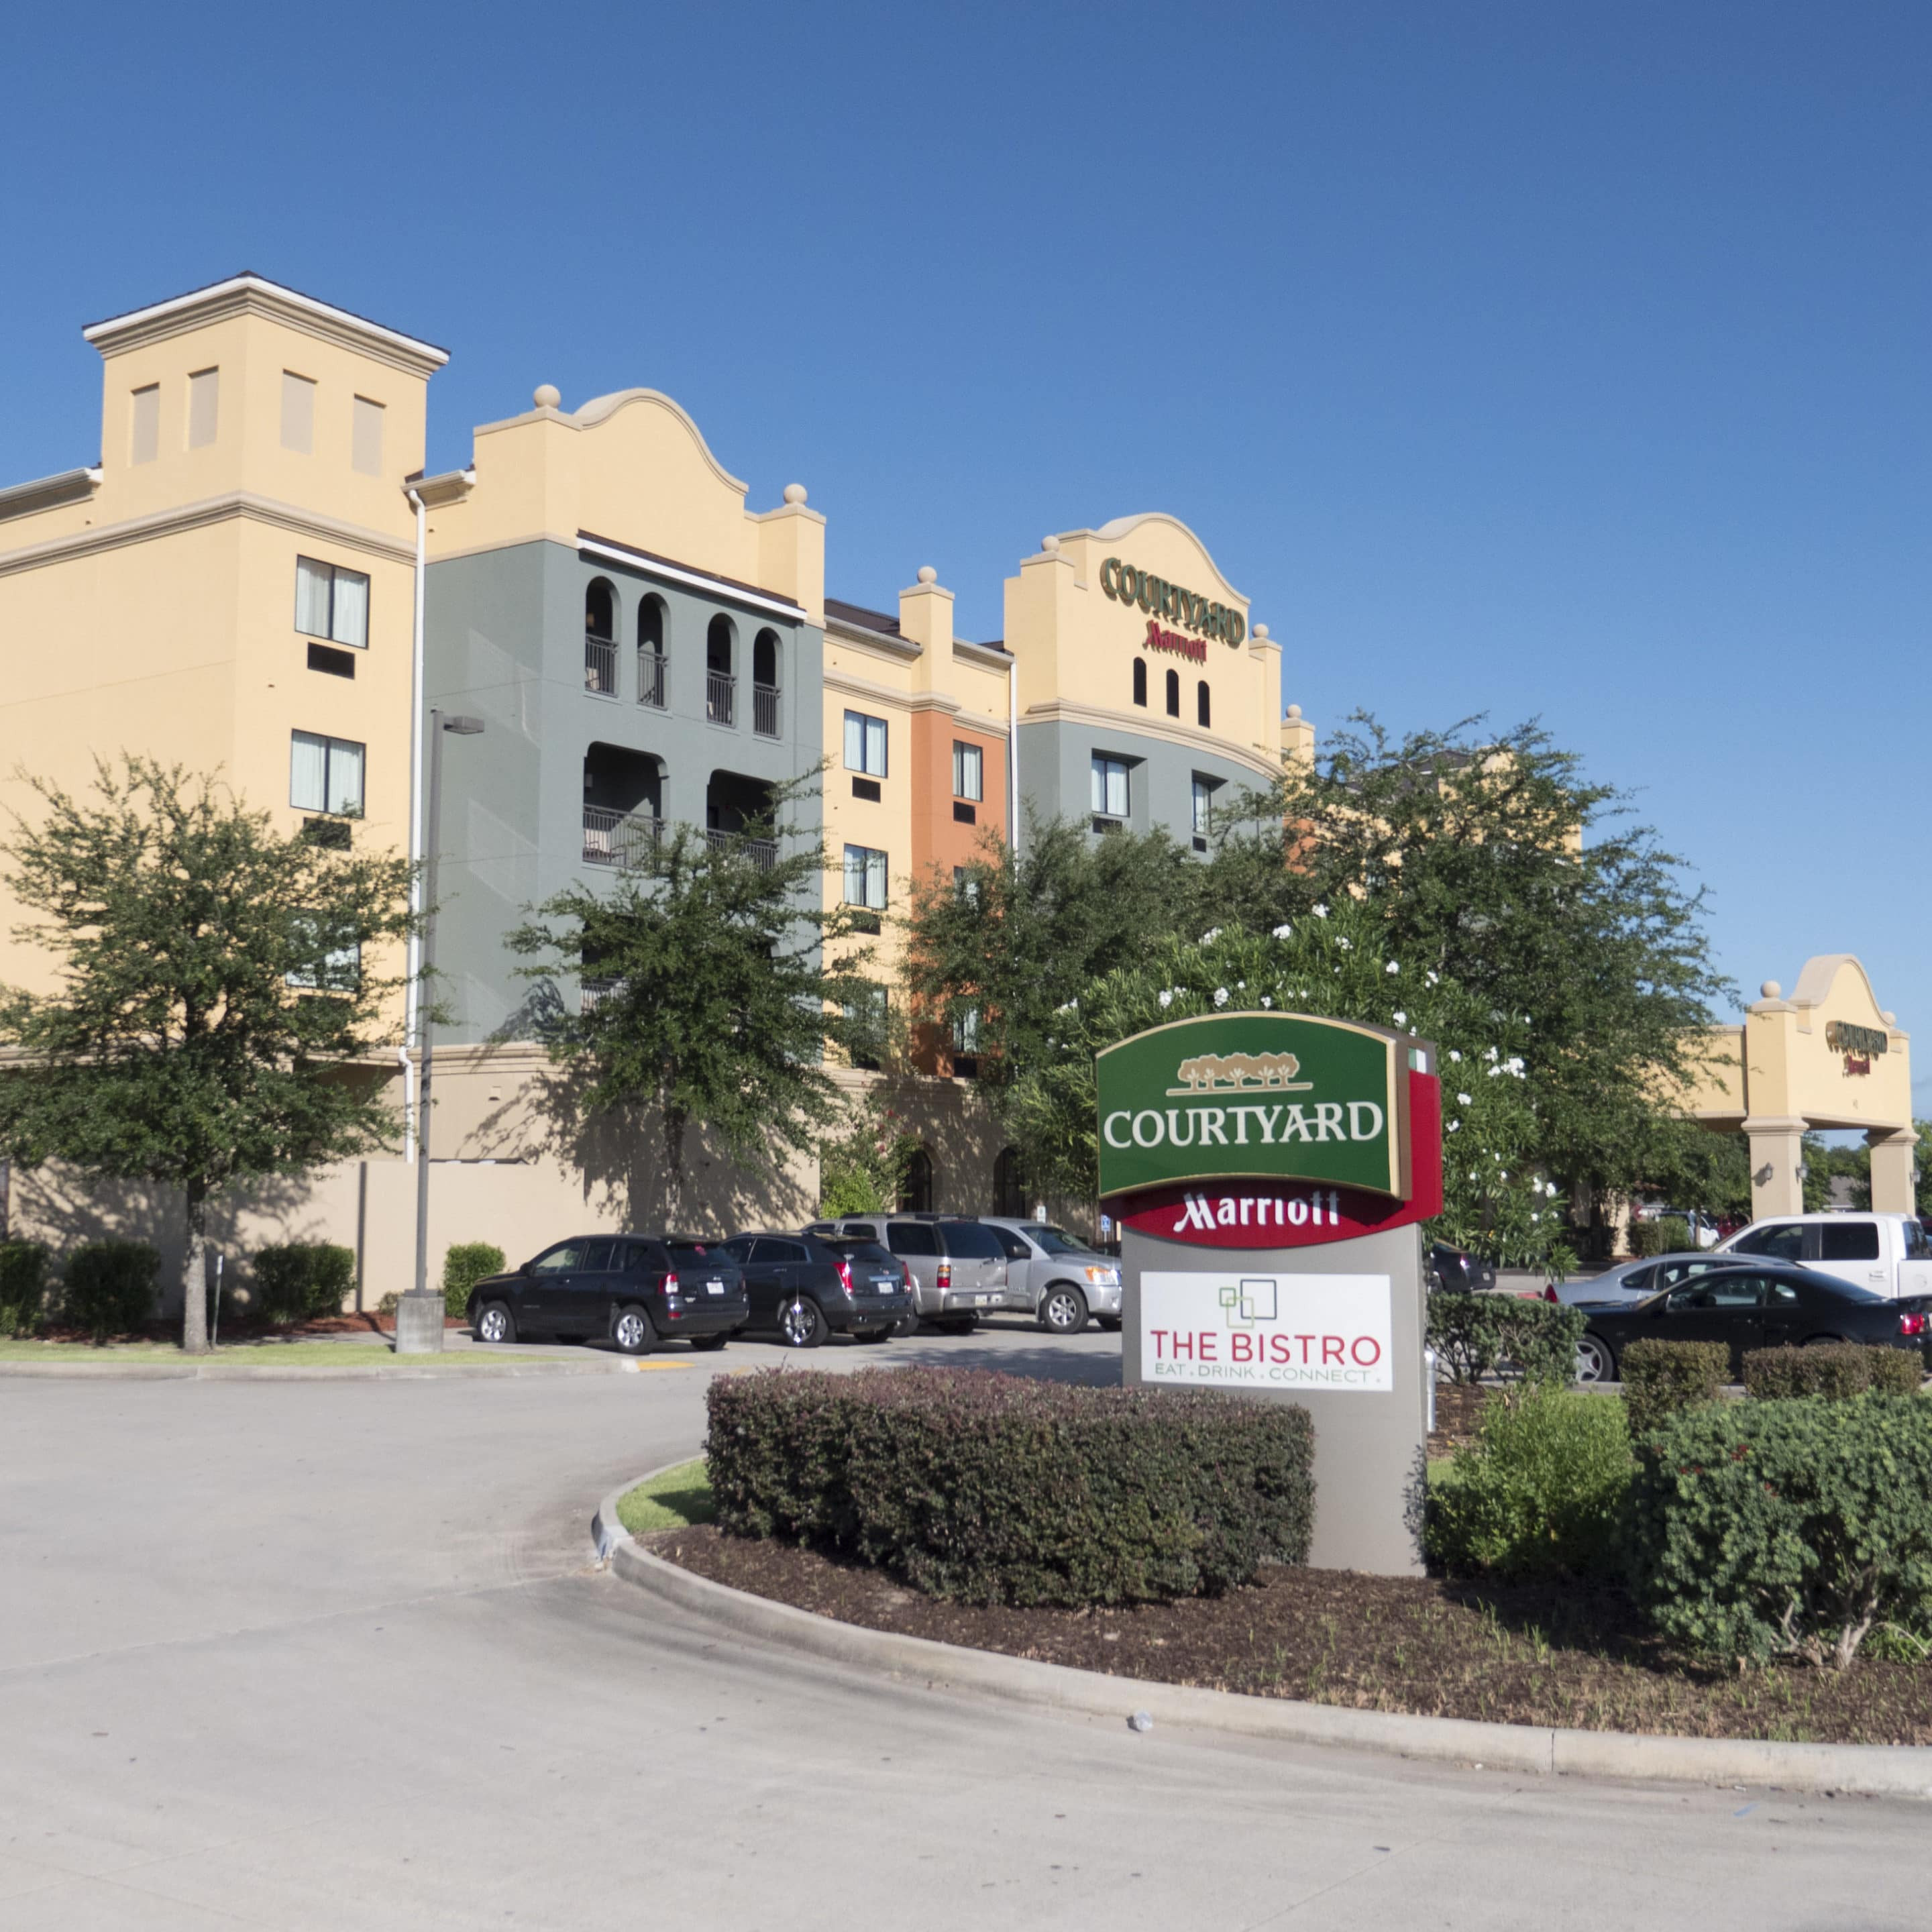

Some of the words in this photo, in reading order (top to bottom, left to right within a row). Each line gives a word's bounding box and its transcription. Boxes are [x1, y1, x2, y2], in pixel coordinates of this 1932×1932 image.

[1100, 557, 1245, 648] COURTYARD
[1104, 1101, 1383, 1148] COURTYARD
[1173, 1191, 1340, 1233] Marriott
[1150, 1330, 1217, 1360] THE
[1232, 1333, 1381, 1366] BISTRO
